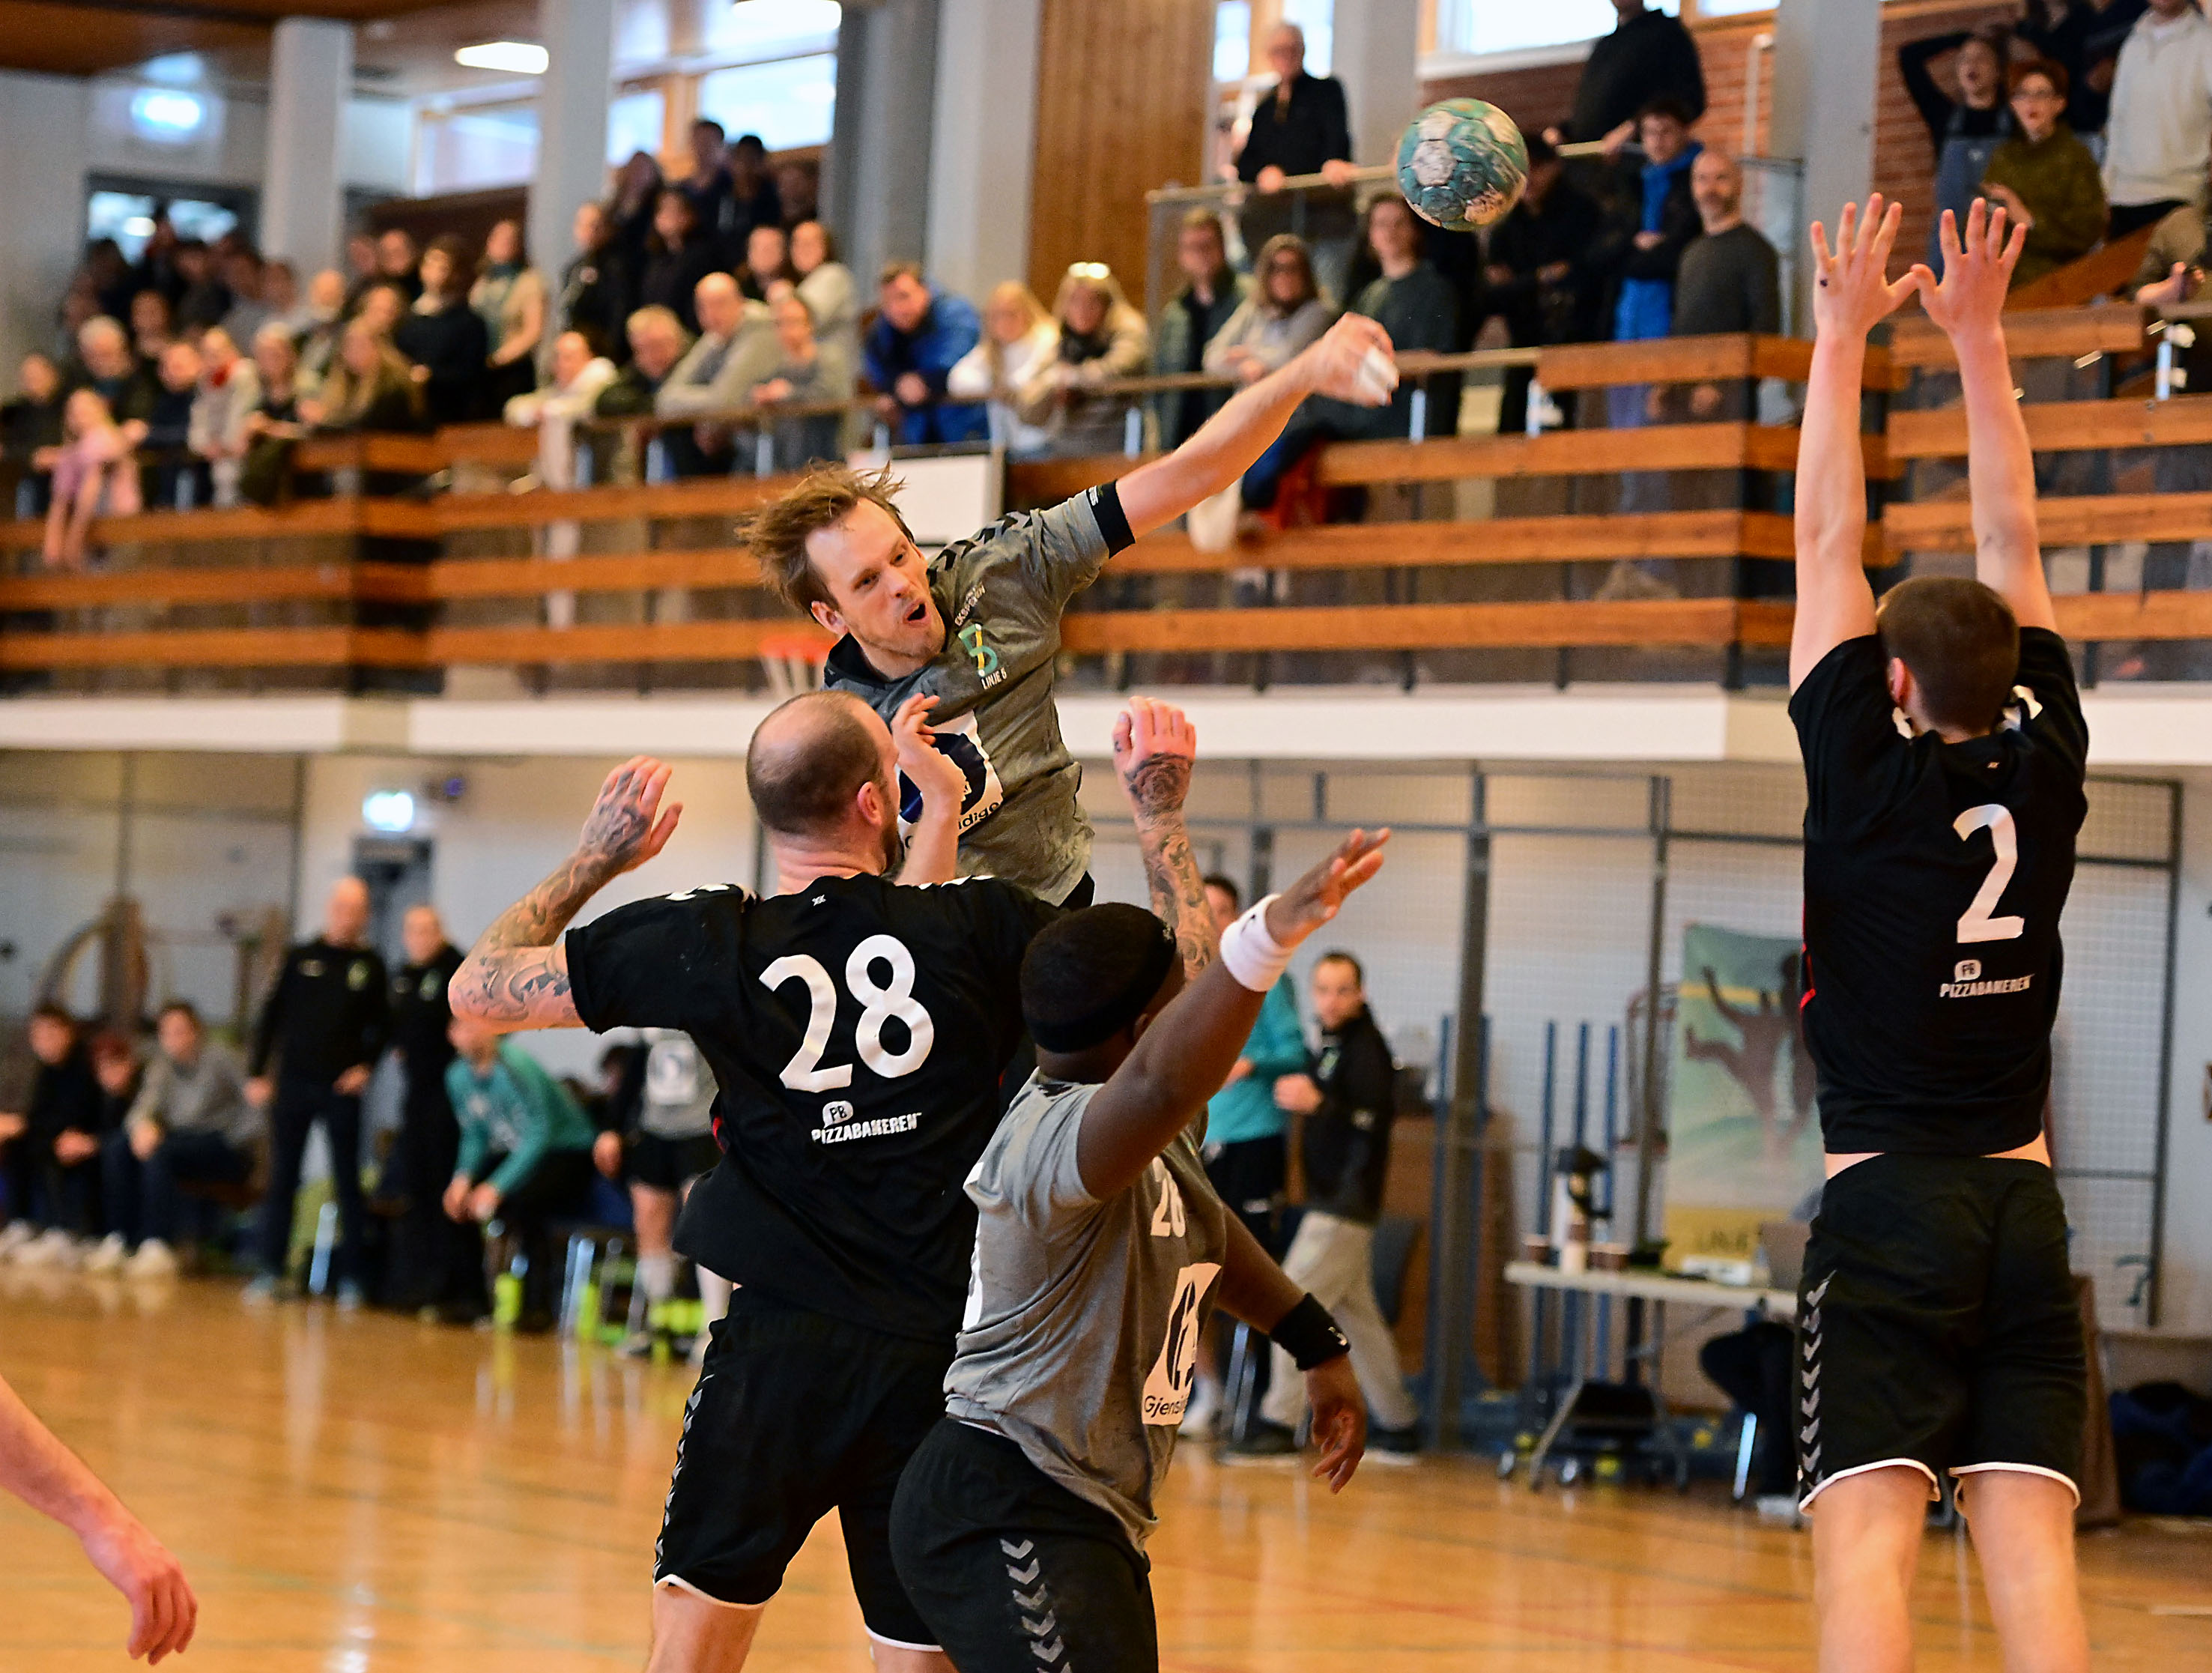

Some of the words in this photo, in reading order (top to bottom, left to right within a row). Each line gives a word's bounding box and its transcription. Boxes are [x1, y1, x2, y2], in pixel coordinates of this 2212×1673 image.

[1953, 804, 2025, 943] 2
[759, 934, 934, 1093] 28
[811, 1113, 918, 1144] PIZZABAKEREN
[829, 1105, 847, 1122] PB
